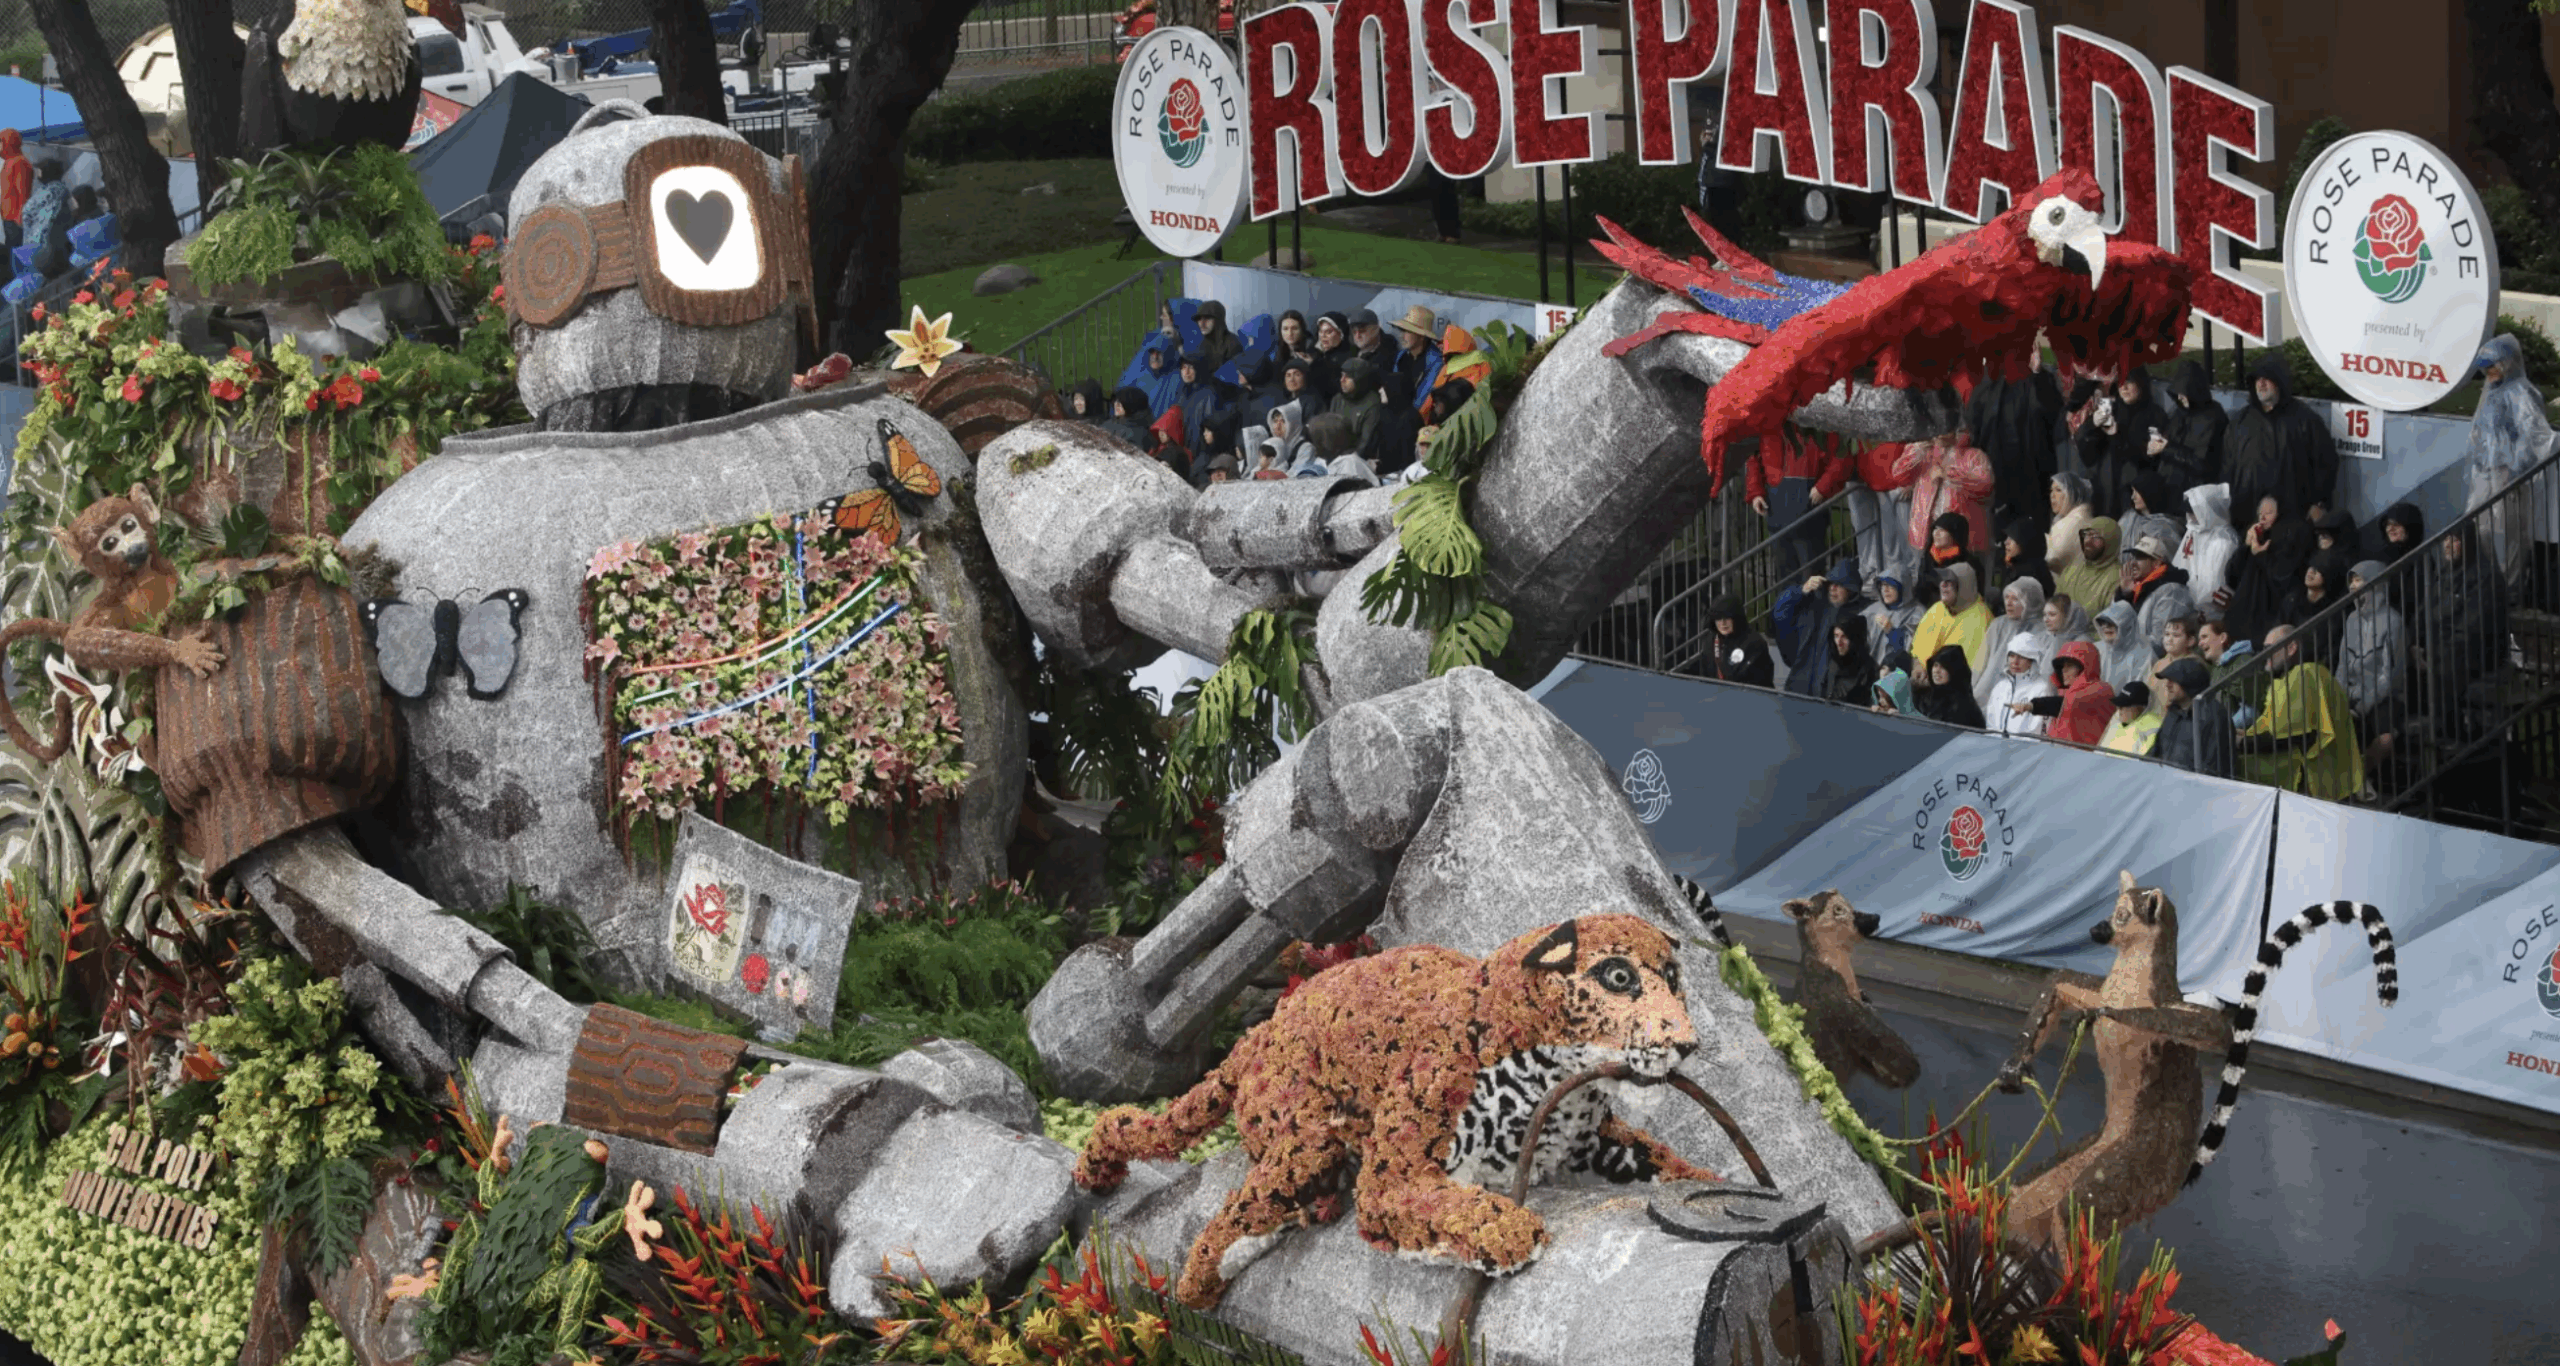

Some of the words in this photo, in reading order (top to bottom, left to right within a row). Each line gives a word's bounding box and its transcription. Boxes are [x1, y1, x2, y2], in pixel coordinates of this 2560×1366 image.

[1129, 48, 1164, 137] ROSE
[1170, 39, 1240, 147] PARADE
[1242, 0, 1608, 223] ROSE
[1628, 0, 2282, 347] PARADE
[1150, 210, 1221, 234] HONDA
[2310, 158, 2361, 264] ROSE
[2371, 147, 2480, 279] PARADE
[2340, 352, 2449, 384] HONDA
[2363, 321, 2411, 336] presented
[2413, 322, 2426, 343] by
[2345, 409, 2369, 438] 15
[1913, 778, 1948, 850] ROSE
[1956, 773, 2015, 870] PARADE
[1917, 911, 1985, 934] HONDA
[2503, 904, 2558, 983] ROSE
[106, 1122, 151, 1175] CAL
[149, 1138, 215, 1192] POLY
[62, 1169, 218, 1250] UNIVERSITIES
